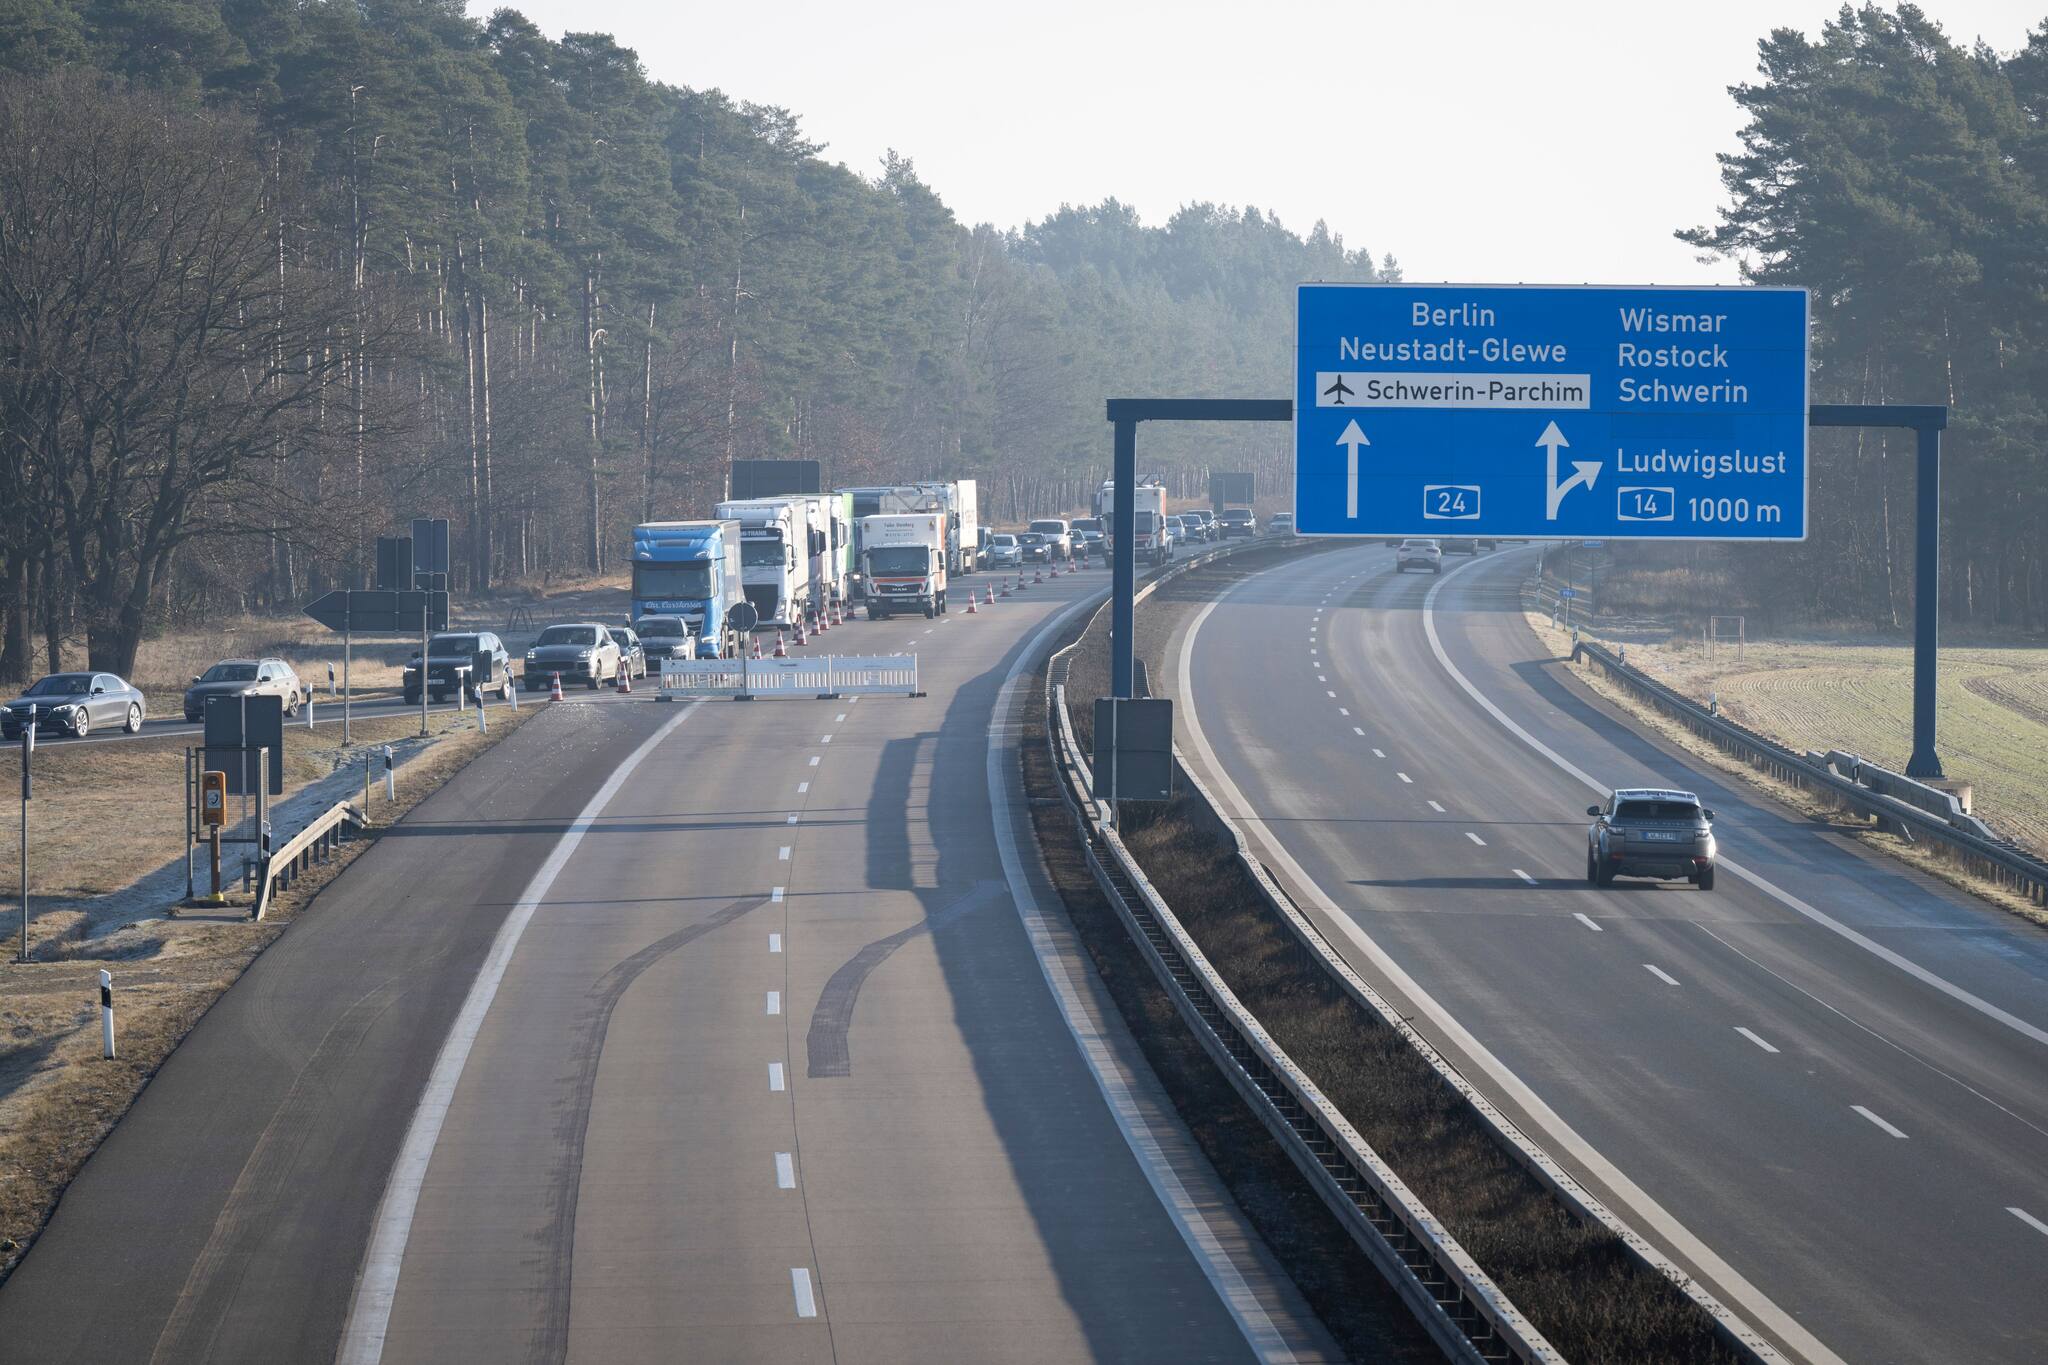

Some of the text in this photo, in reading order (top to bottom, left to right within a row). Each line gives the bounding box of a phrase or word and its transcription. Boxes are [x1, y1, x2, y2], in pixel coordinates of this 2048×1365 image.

[1412, 302, 1495, 326] Berlin
[1620, 308, 1727, 332] Wismar
[1340, 336, 1566, 362] Neustadt-Glewe
[1619, 343, 1728, 367] Rostock
[1367, 379, 1583, 402] Schwerin-Parchim
[1619, 378, 1747, 403] Schwerin
[1618, 448, 1786, 479] Ludwigslust
[1438, 492, 1466, 512] 24
[1634, 494, 1658, 514] 14
[1688, 498, 1780, 522] 1000 m
